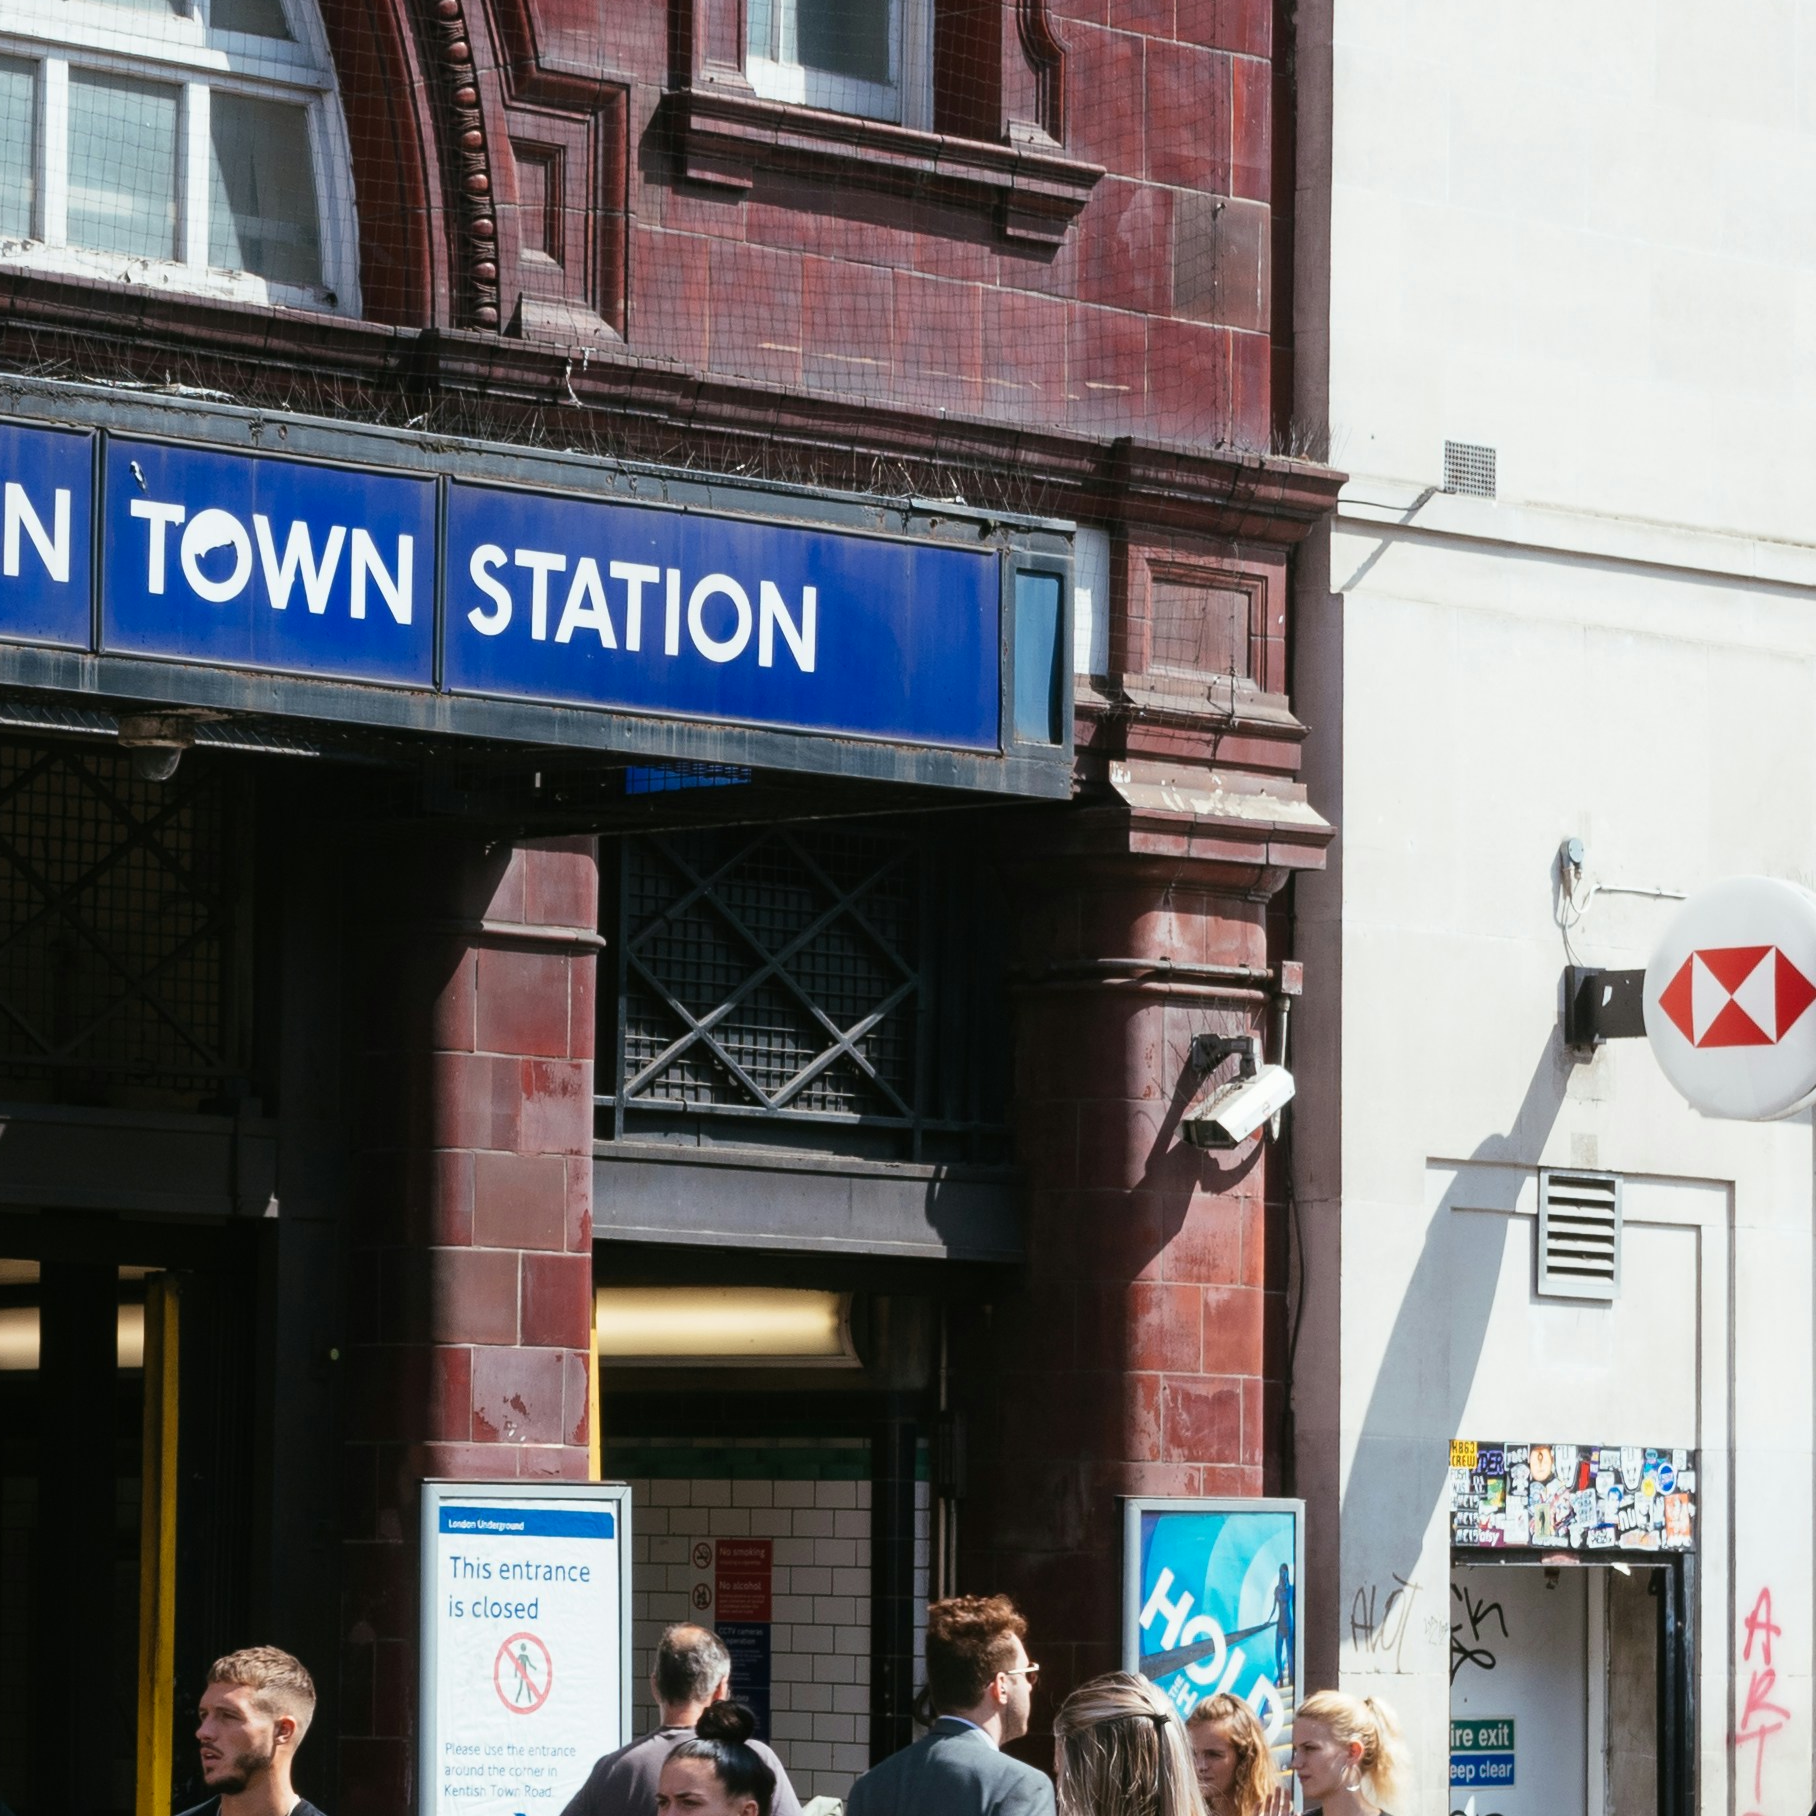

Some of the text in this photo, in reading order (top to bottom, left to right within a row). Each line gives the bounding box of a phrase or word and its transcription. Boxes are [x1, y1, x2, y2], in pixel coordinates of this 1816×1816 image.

[130, 497, 414, 626] TOWN
[468, 544, 817, 673] STATION
[448, 1519, 524, 1532] London Underground
[450, 1555, 590, 1582] This entrance
[449, 1594, 539, 1619] is closed
[1450, 1722, 1510, 1747] ire exit
[445, 1742, 577, 1757] Please use the entrance
[444, 1765, 558, 1777] around the corner in
[1450, 1760, 1513, 1783] eep clear
[444, 1784, 552, 1797] Kentish Town Road
